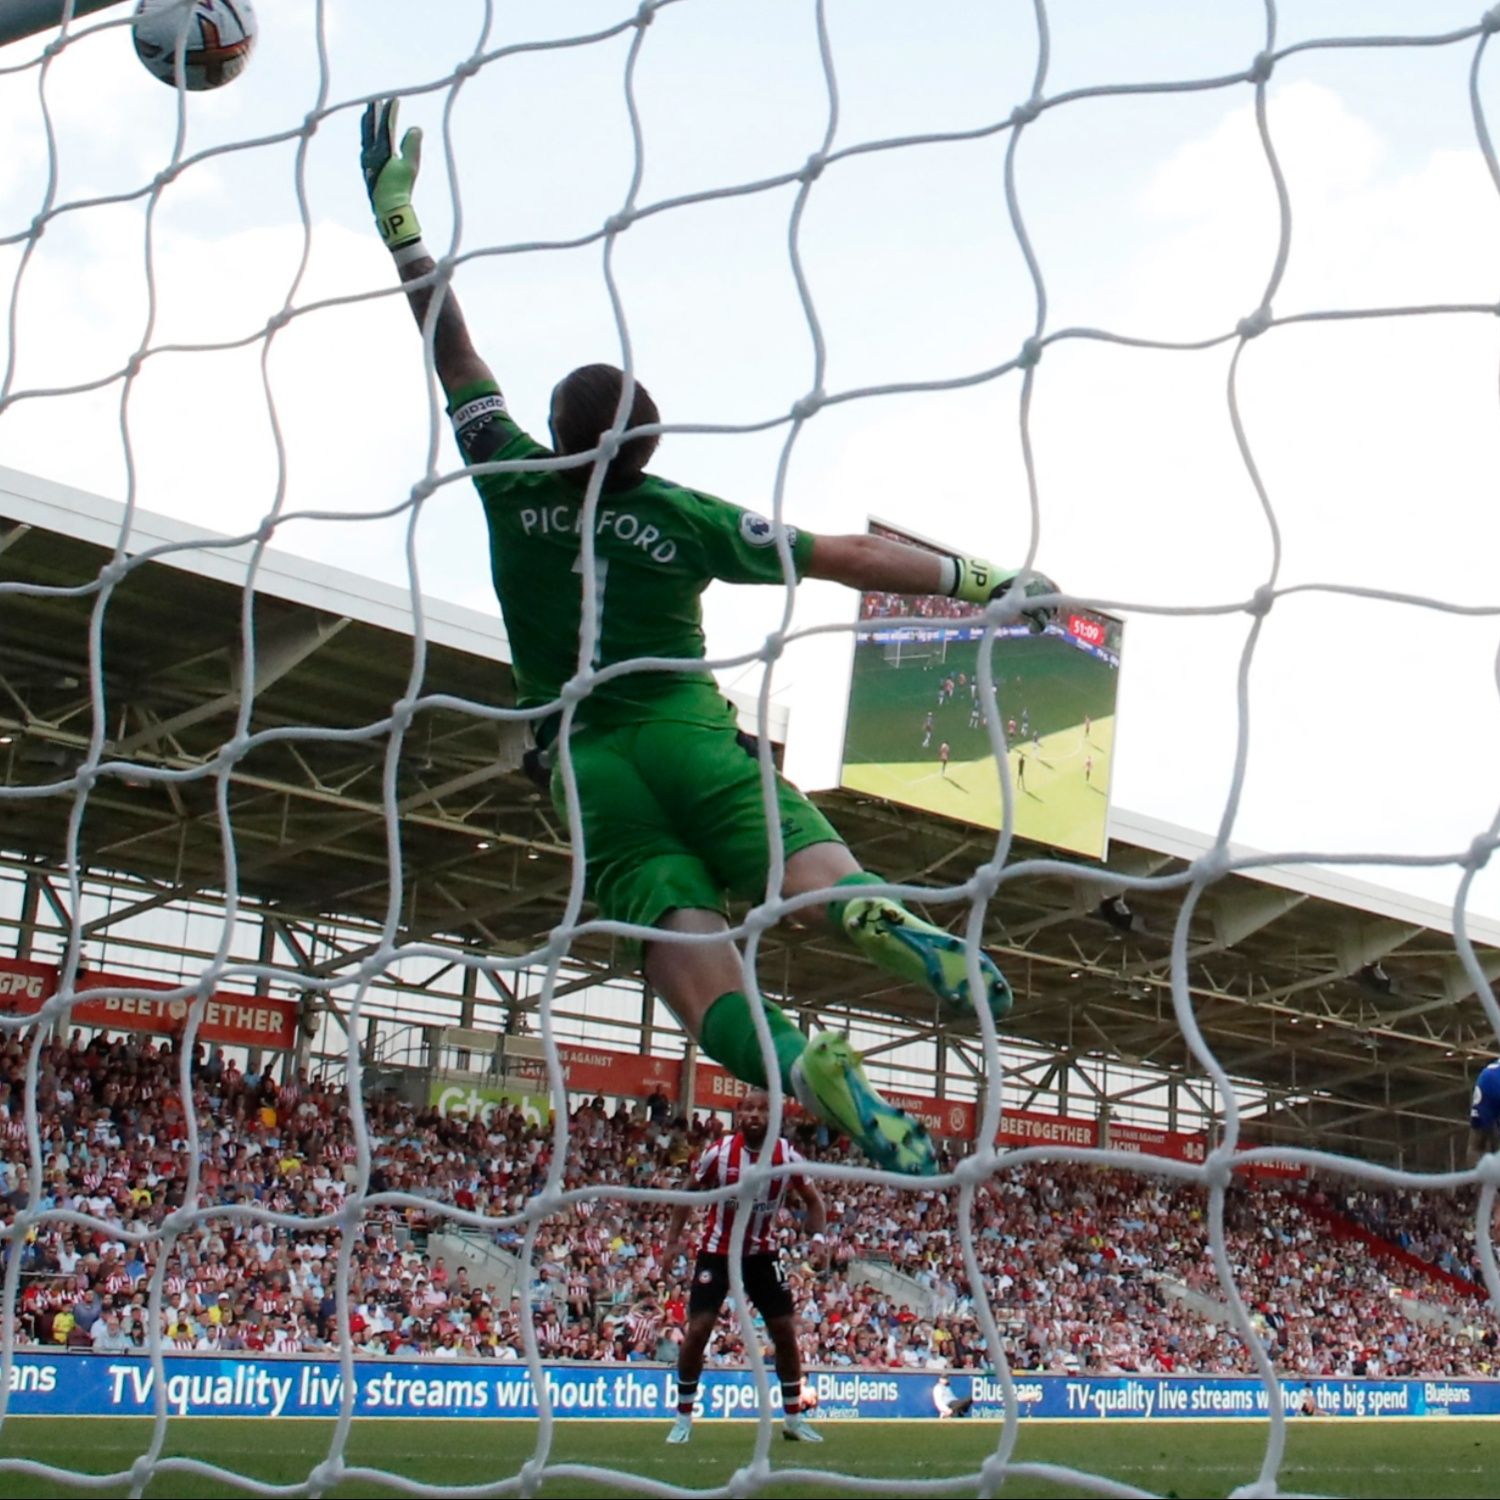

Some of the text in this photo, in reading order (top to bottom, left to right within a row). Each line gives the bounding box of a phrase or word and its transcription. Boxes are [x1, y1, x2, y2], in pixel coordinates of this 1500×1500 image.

[457, 397, 504, 421] aptain
[1073, 620, 1099, 641] 51:09
[439, 1086, 541, 1130] Gteh
[109, 1364, 291, 1416] TVquality
[366, 1372, 488, 1408] streams
[614, 1373, 658, 1409] the
[818, 1374, 898, 1407] BlueJeans
[1066, 1380, 1155, 1417] TV-quality
[1159, 1381, 1187, 1409] live
[1191, 1384, 1252, 1410] streams
[1317, 1384, 1340, 1409] the
[1343, 1383, 1365, 1415] big
[1368, 1384, 1408, 1416] spend
